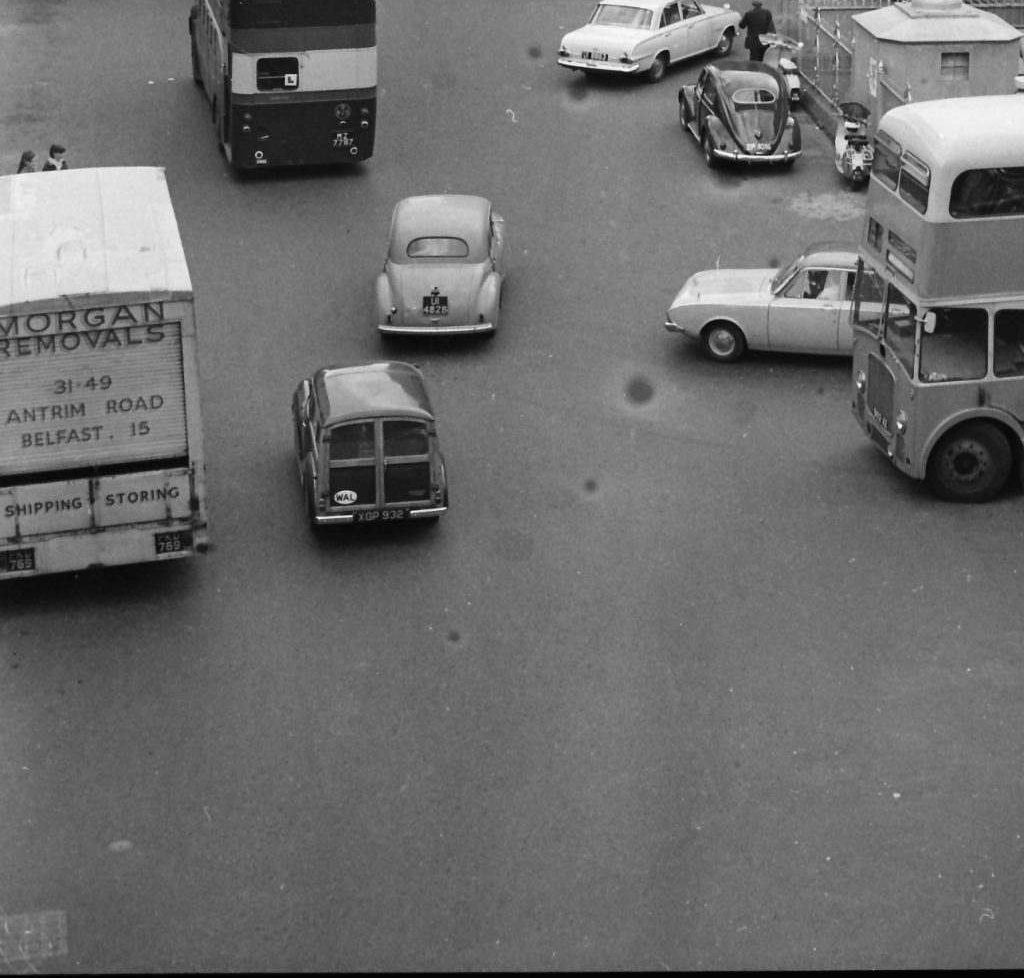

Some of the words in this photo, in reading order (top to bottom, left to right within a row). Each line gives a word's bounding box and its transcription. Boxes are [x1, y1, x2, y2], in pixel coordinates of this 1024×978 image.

[287, 76, 295, 84] L
[0, 301, 164, 335] MORGAN
[0, 325, 166, 358] REMOVALS
[6, 402, 86, 424] ANTRIM
[105, 394, 164, 415] ROAD
[130, 421, 150, 437] 15
[4, 497, 82, 518] SHIPPING
[105, 486, 180, 507] STORING
[336, 492, 356, 502] WAL
